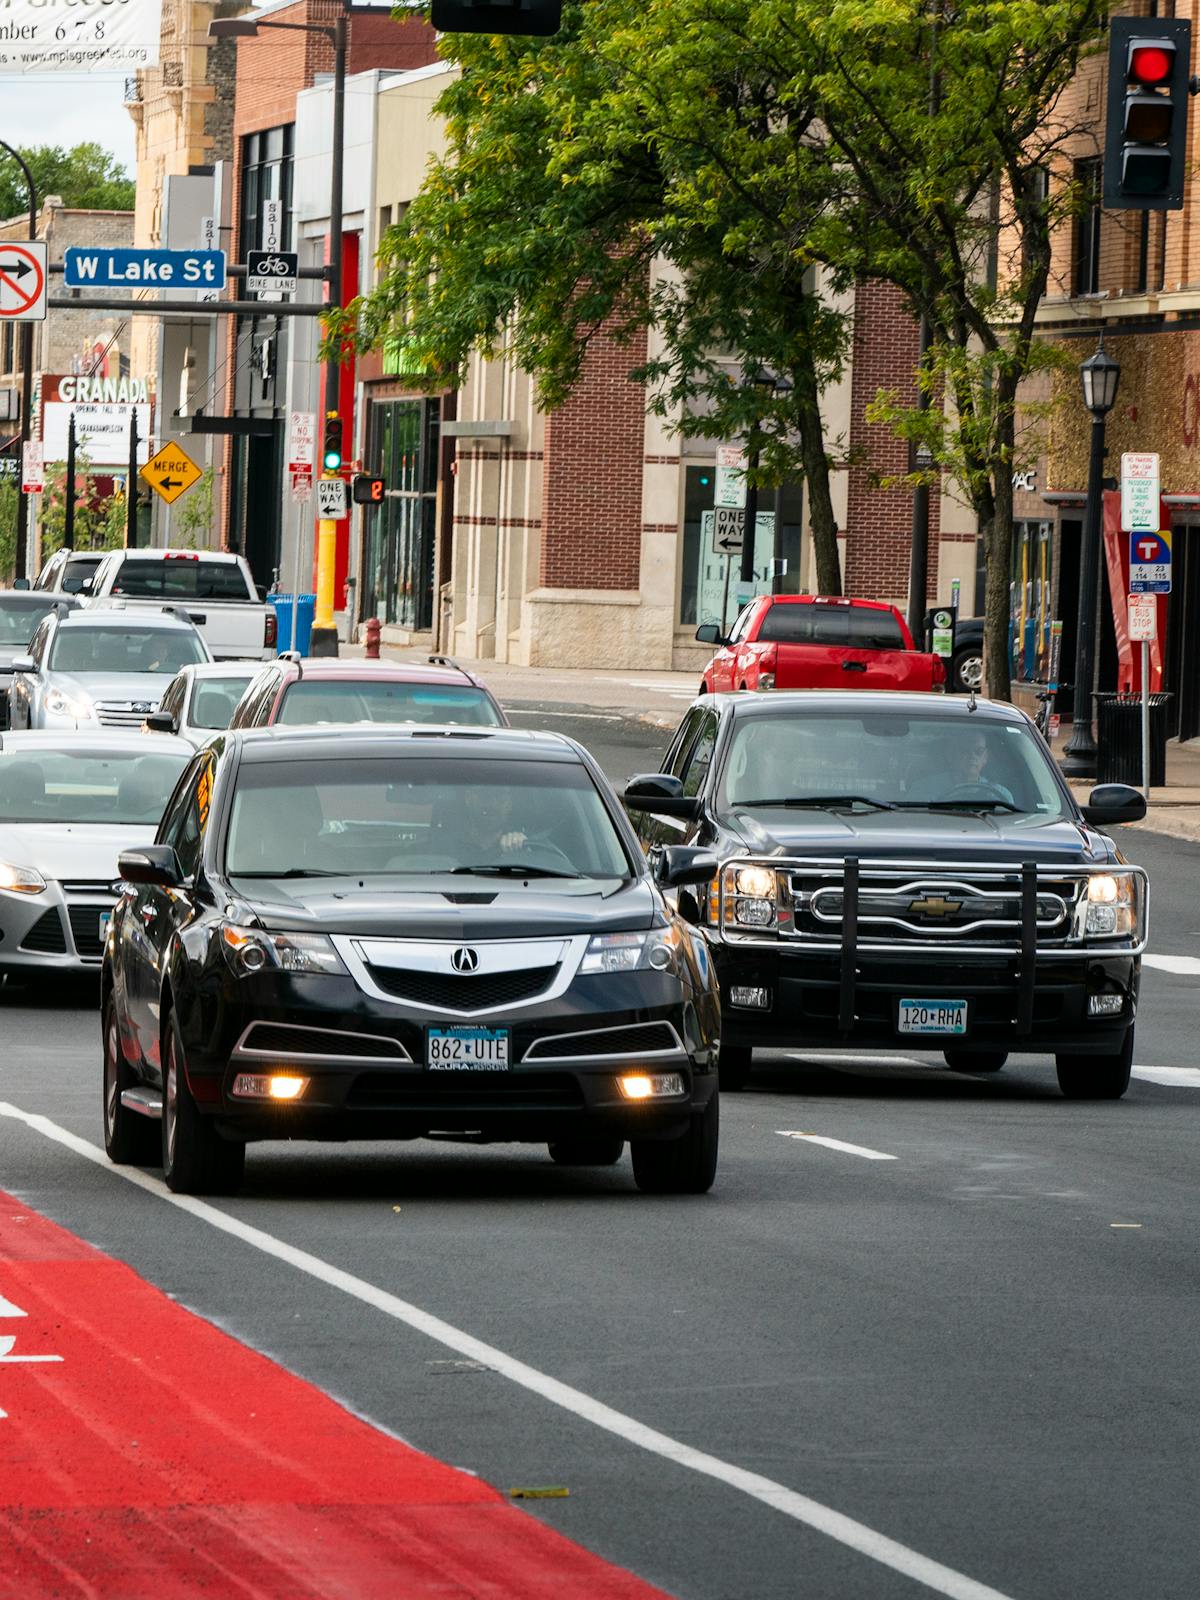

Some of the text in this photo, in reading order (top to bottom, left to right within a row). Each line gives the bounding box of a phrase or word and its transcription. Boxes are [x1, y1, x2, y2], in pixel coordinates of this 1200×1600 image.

[94, 20, 105, 40] 8
[76, 256, 215, 282] W Lake St
[249, 278, 295, 290] BIKE LANE
[58, 376, 148, 403] GRANADA
[154, 461, 189, 473] MERGE
[319, 482, 341, 493] ONE
[320, 494, 342, 504] WAY
[719, 511, 745, 523] ONE
[718, 523, 745, 536] WAY
[1138, 542, 1158, 560] T
[1138, 565, 1144, 573] 6
[1135, 608, 1150, 618] BUS
[1132, 619, 1152, 628] STOP
[903, 1008, 962, 1025] 120 RHA
[431, 1038, 506, 1060] 862 UTE
[429, 1063, 470, 1071] ACURA
